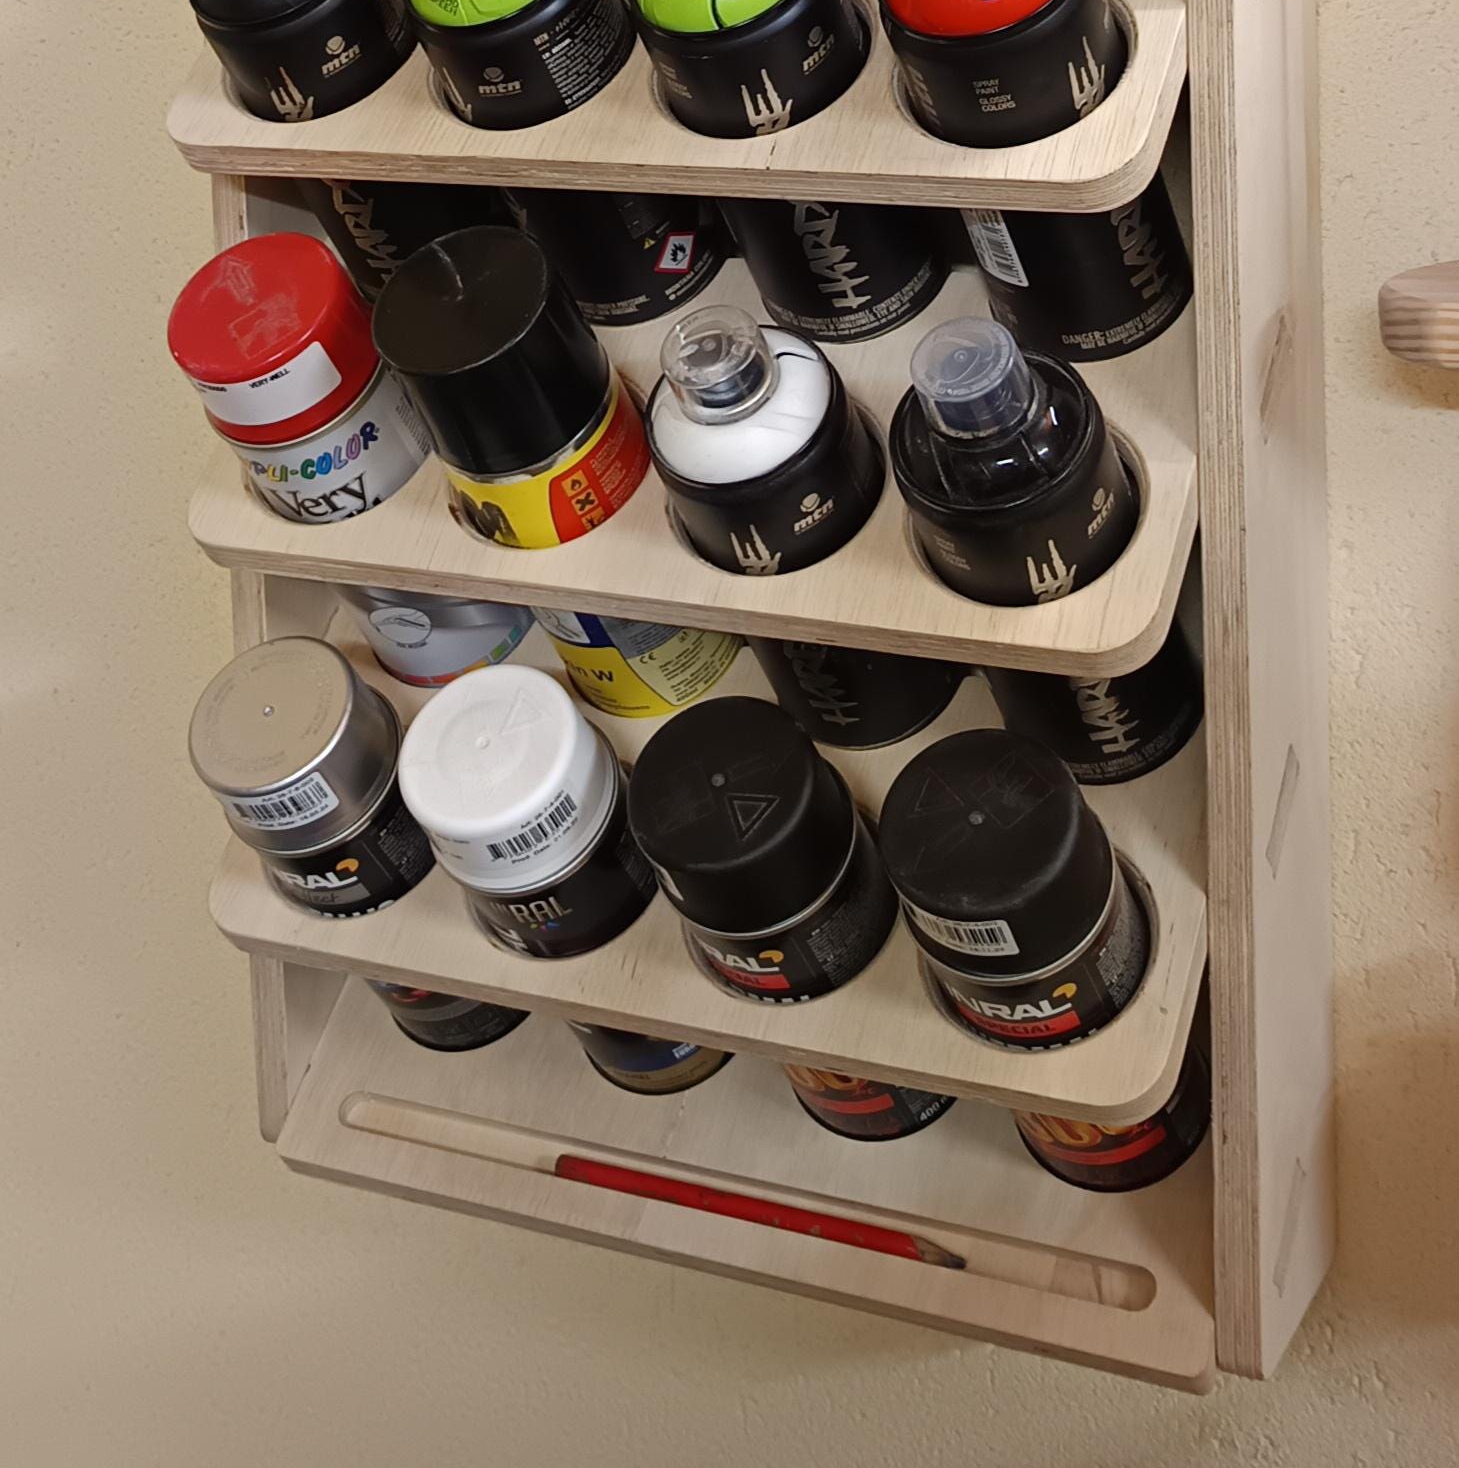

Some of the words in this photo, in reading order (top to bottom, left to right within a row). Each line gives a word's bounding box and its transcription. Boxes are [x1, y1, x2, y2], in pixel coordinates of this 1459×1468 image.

[268, 471, 370, 519] Very
[590, 668, 614, 683] W
[918, 1102, 941, 1123] 400
